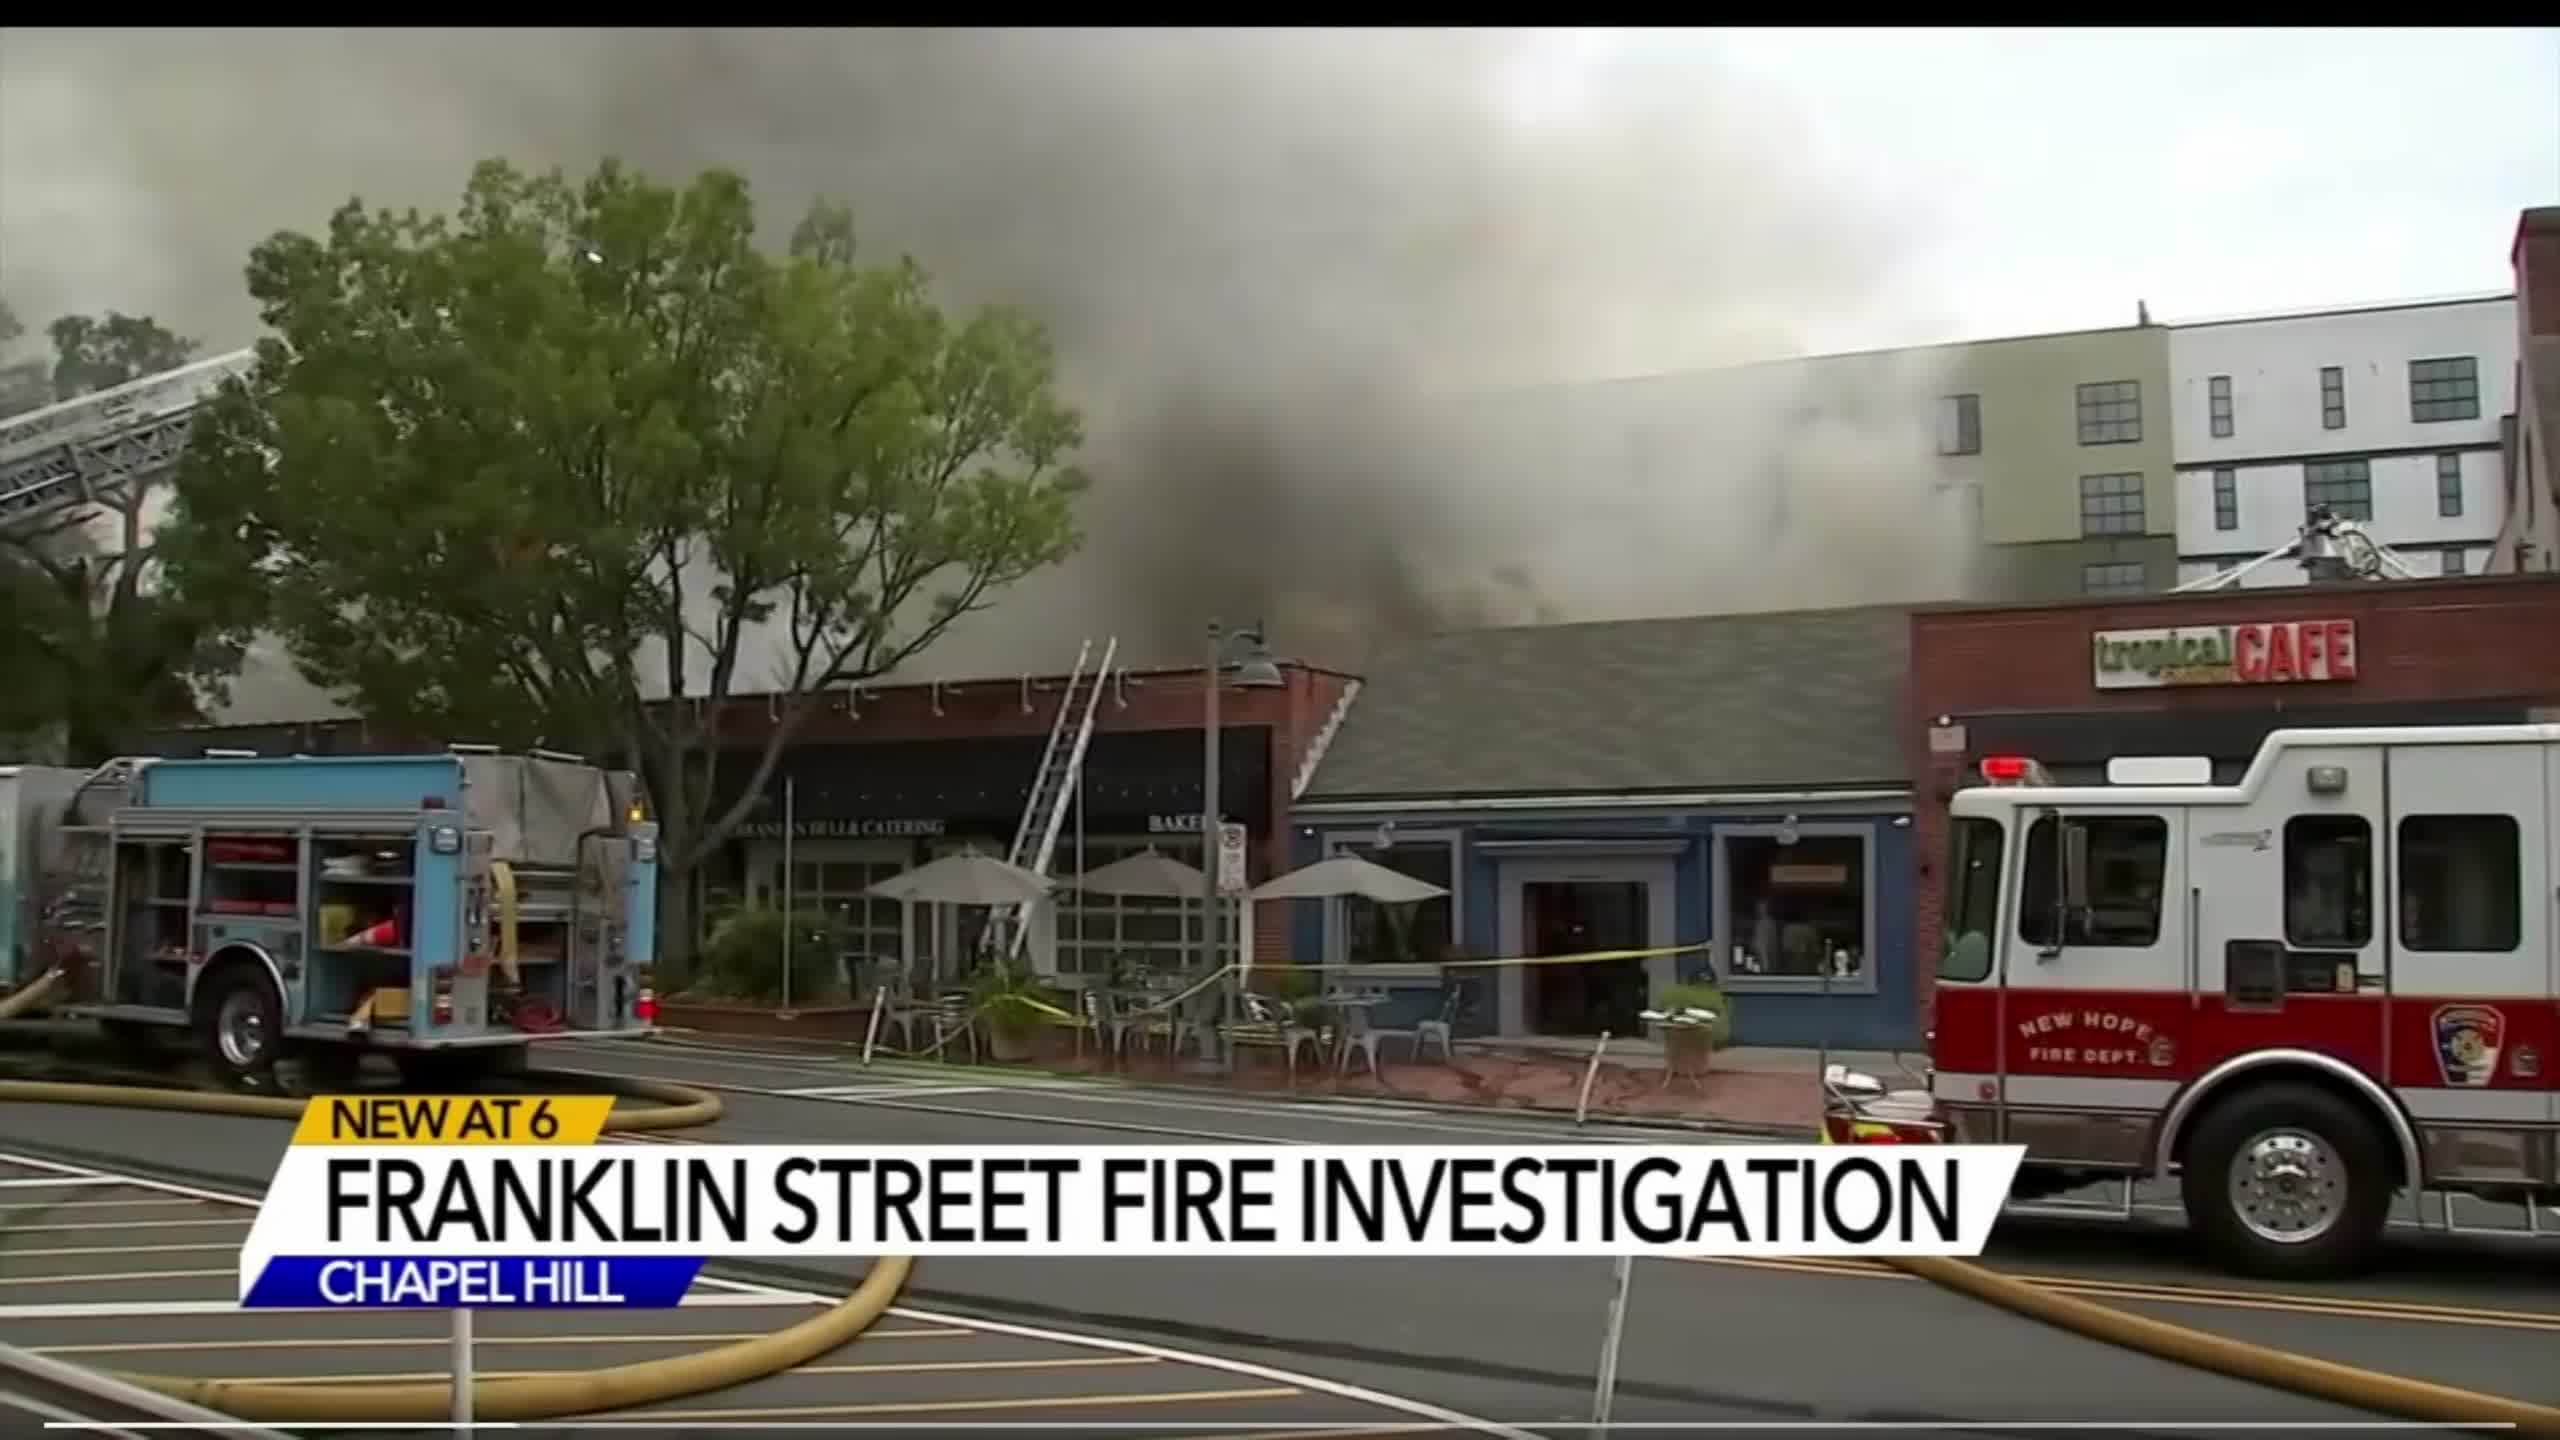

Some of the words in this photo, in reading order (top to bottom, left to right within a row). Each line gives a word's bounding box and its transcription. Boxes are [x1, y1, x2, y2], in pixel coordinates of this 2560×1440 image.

[2095, 626, 2232, 678] tropical
[2235, 621, 2356, 681] CAFE
[861, 818, 946, 836] CATERING
[2018, 1011, 2074, 1039] NEW
[2083, 1010, 2153, 1042] HOPE
[2029, 1047, 2077, 1063] FIRE
